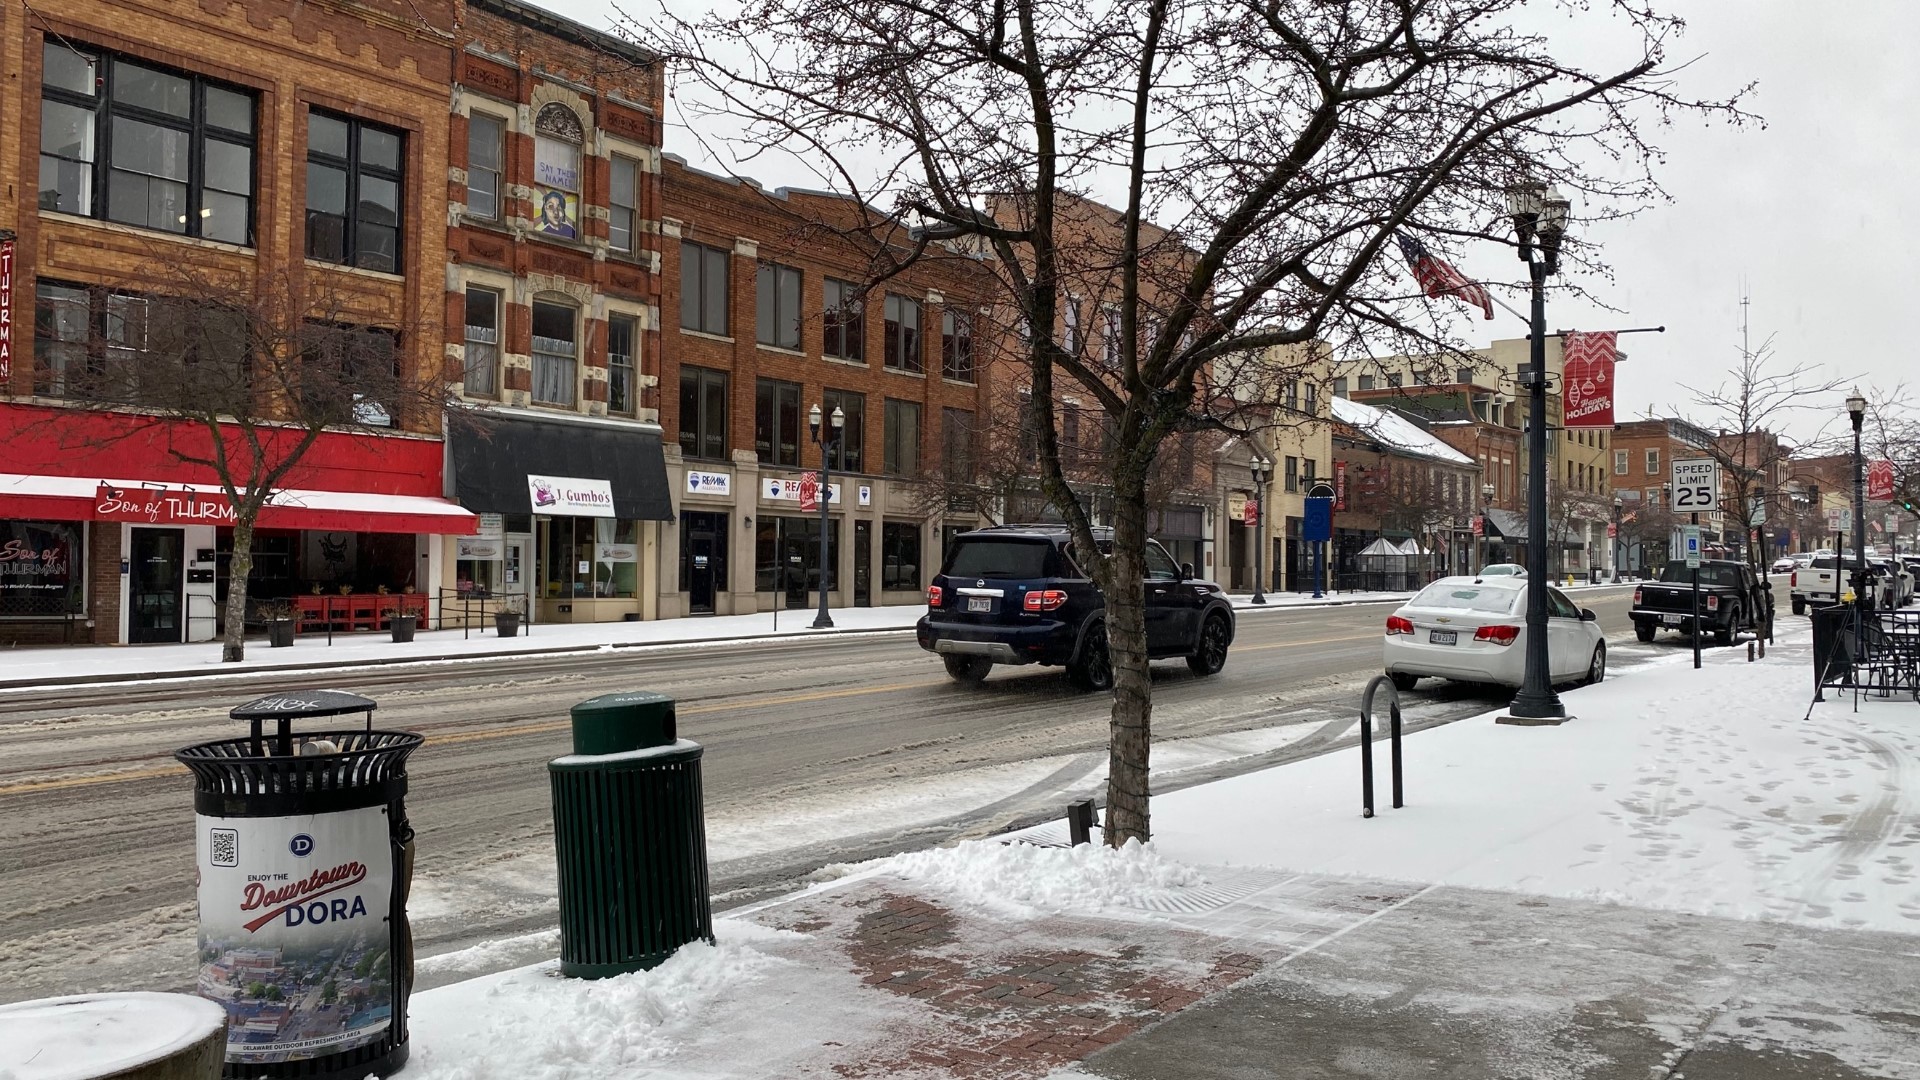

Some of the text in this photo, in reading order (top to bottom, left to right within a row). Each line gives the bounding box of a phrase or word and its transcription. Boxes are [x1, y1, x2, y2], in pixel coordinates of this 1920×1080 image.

[540, 161, 553, 174] SAY
[0, 254, 10, 377] THURMAN
[1566, 400, 1611, 420] HOLIDAYS
[1580, 395, 1608, 408] Happy
[1675, 464, 1712, 474] SPEED
[702, 475, 726, 486] RE/MAX
[1679, 475, 1708, 485] LIMIT
[97, 490, 238, 522] Son of THURM
[557, 489, 610, 503] J. Gumbo's
[1677, 486, 1712, 506] 25
[0, 540, 59, 566] Son of
[240, 861, 366, 911] Downtown
[247, 873, 289, 882] ENJOY THE
[285, 895, 367, 928] DORA
[274, 1041, 303, 1050] OUTDOOR
[304, 1034, 345, 1047] REFRESHMENT
[346, 1030, 361, 1038] AREA
